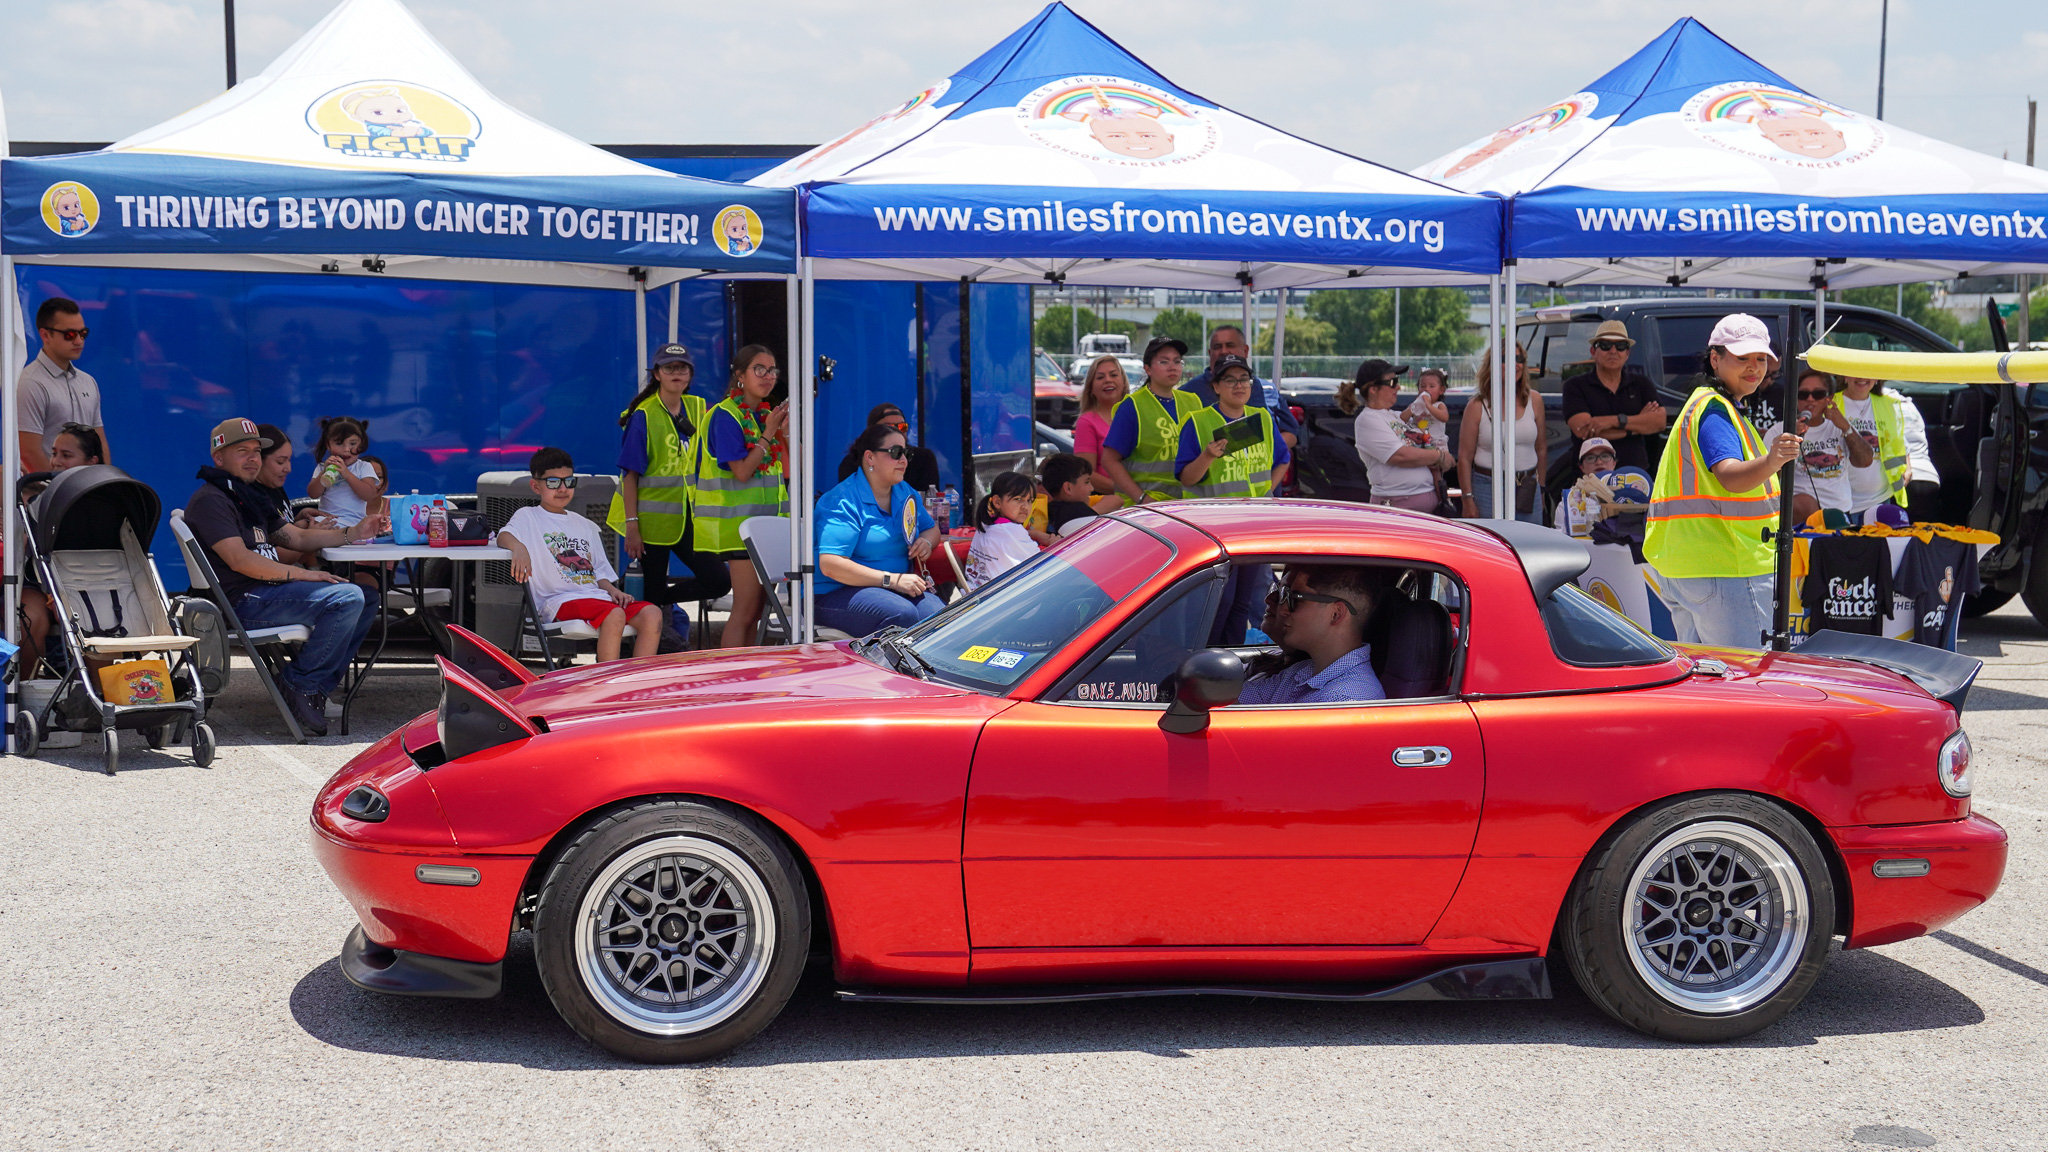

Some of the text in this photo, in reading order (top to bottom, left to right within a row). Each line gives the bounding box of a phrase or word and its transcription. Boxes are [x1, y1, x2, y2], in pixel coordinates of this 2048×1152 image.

[1062, 76, 1118, 86] FROM
[325, 133, 474, 157] FIGHT
[343, 148, 395, 158] LIKE
[421, 153, 463, 163] KID
[114, 195, 700, 246] THRIVING BEYOND CANCER TOGETHER!
[873, 200, 1446, 254] www.smilesfromheaventx.org
